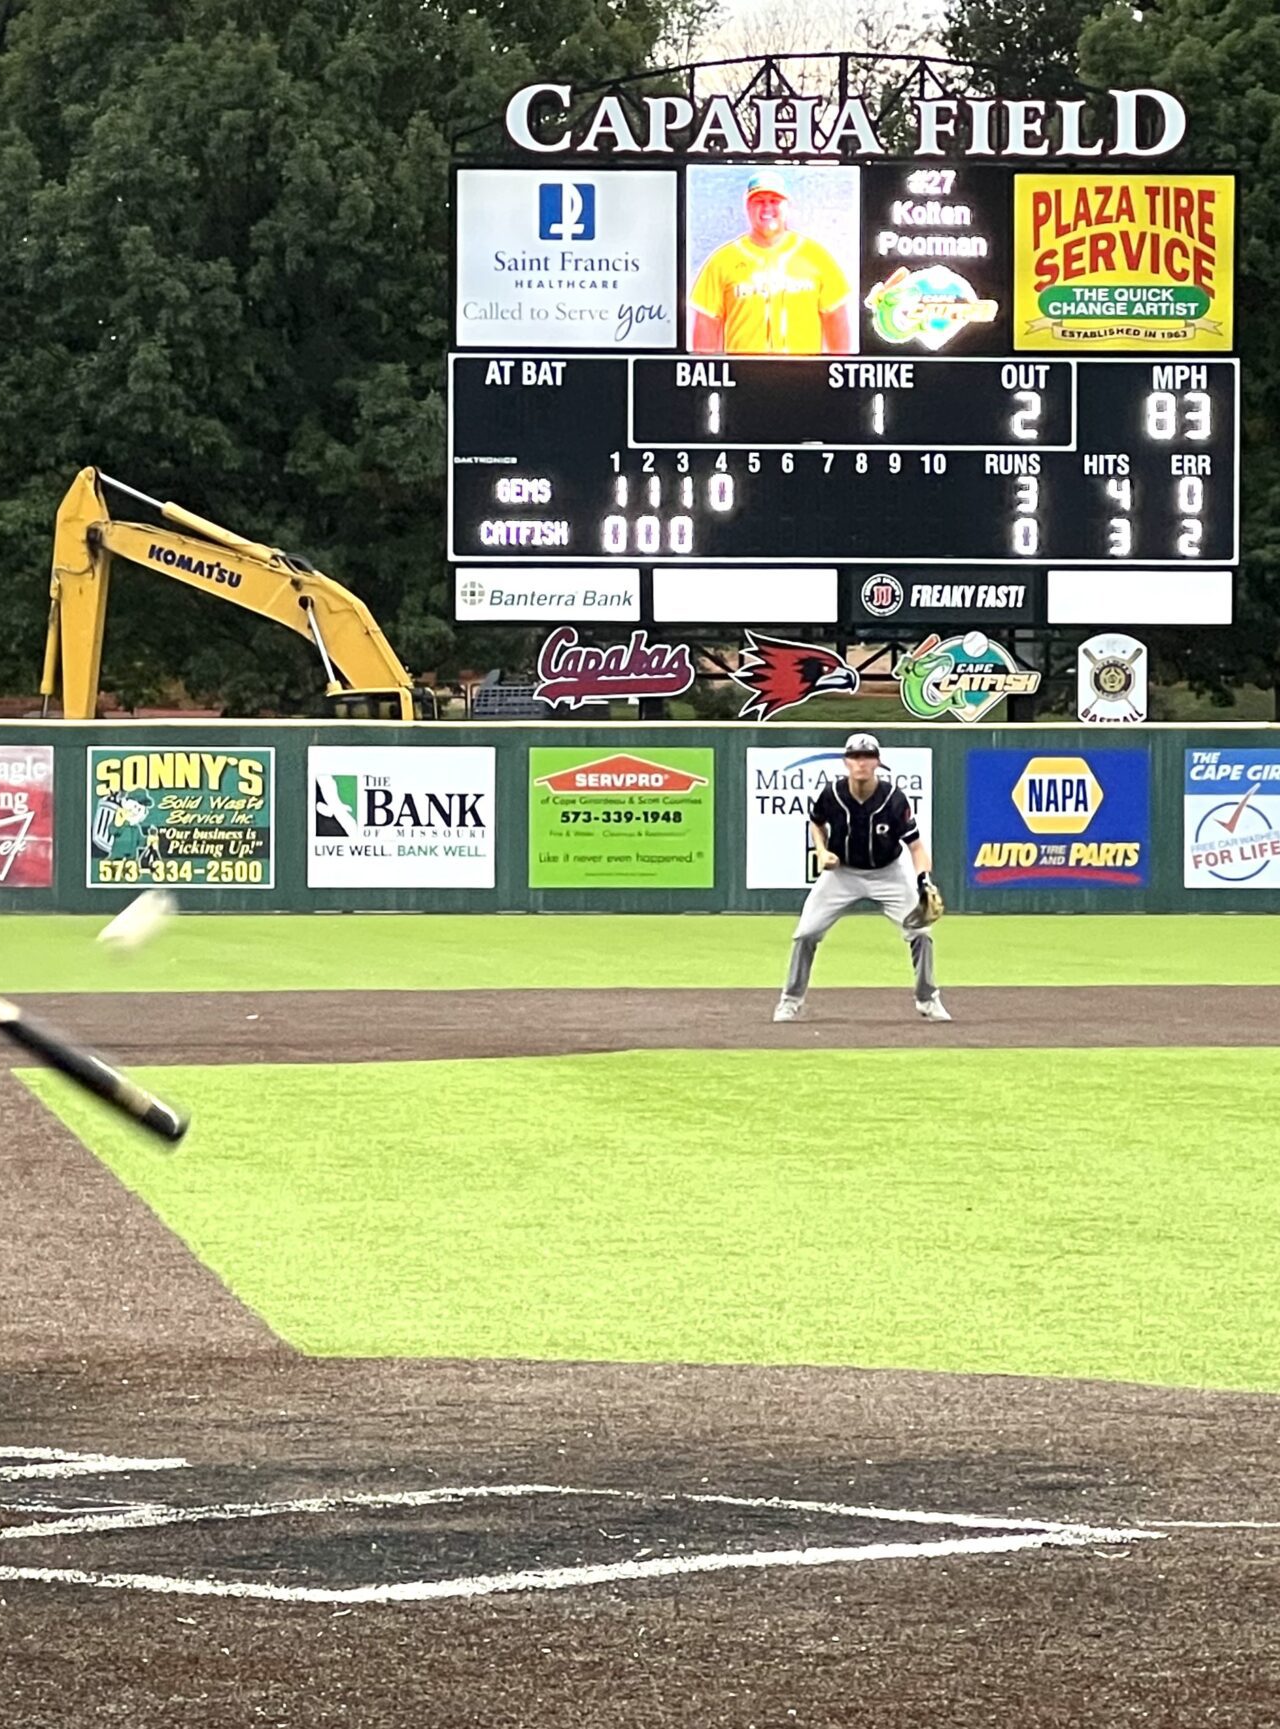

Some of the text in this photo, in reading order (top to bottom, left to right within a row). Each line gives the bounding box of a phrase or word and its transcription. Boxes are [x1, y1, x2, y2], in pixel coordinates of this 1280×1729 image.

[505, 83, 1187, 156] CAPAHA FIELD
[1032, 186, 1216, 251] PLAZA TIRE
[878, 232, 988, 258] Poorman
[494, 250, 640, 273] Saint Francis
[1034, 231, 1216, 299] SERVICE
[515, 279, 619, 289] HEALTHCARE
[1072, 287, 1174, 303] THE QUICK
[463, 301, 522, 322] Called
[530, 305, 549, 322] to
[555, 302, 609, 322] Serve
[1048, 301, 1199, 316] CHANGE ARTIST
[1060, 327, 1141, 340] ESTABLISHED
[1144, 330, 1156, 340] IN
[485, 361, 567, 386] AT BAT
[676, 362, 736, 387] BALL
[828, 364, 914, 389] STRIKE
[1001, 365, 1050, 389] OUT
[1152, 366, 1207, 390] MPH
[708, 392, 720, 434] 1
[872, 392, 885, 435] 1
[1011, 391, 1041, 439] 2
[1146, 391, 1211, 439] 83
[610, 451, 946, 474] 1 2 3 4 5 6 7 8 9 10
[985, 453, 1041, 475] RUNS
[1084, 454, 1130, 475] HITS
[1171, 454, 1211, 475] ERR
[496, 478, 551, 503] GEMS
[616, 473, 1202, 513] 1 1 1 0 3 4 0
[480, 520, 568, 546] CATFISH
[604, 515, 1202, 556] 0 0 0 0 3 2
[148, 544, 242, 588] KOMATSU
[489, 589, 633, 607] Banterra Bank
[910, 585, 1026, 608] FREAKY FAST!
[537, 627, 694, 690] Capahas
[939, 674, 1038, 692] CATFISH
[1192, 752, 1221, 764] THE
[96, 752, 264, 797] SONNY'S
[364, 775, 391, 787] THE
[575, 773, 665, 787] SERVPRO
[1190, 764, 1245, 781] CAPE
[158, 795, 264, 811] Solid Waste
[1028, 778, 1089, 813] NAPA
[166, 811, 224, 825] Service
[364, 789, 486, 828] BANK
[561, 811, 682, 823] 573-339-1948
[159, 828, 190, 840] "Our
[193, 828, 242, 840] business
[364, 829, 486, 839] OF MISSOURI
[1191, 841, 1215, 853] FREE
[1218, 837, 1238, 848] CAR
[168, 841, 263, 858] Picking Up!"
[315, 845, 486, 857] LIVE WELL. BANK WELL.
[539, 852, 558, 863] Like
[563, 852, 570, 863] it
[573, 855, 603, 863] never
[606, 855, 632, 863] even
[974, 842, 1140, 867] AUTO TIRE AND PARTS
[1192, 840, 1280, 869] FOR LIFE
[99, 860, 262, 882] 573-334-2500
